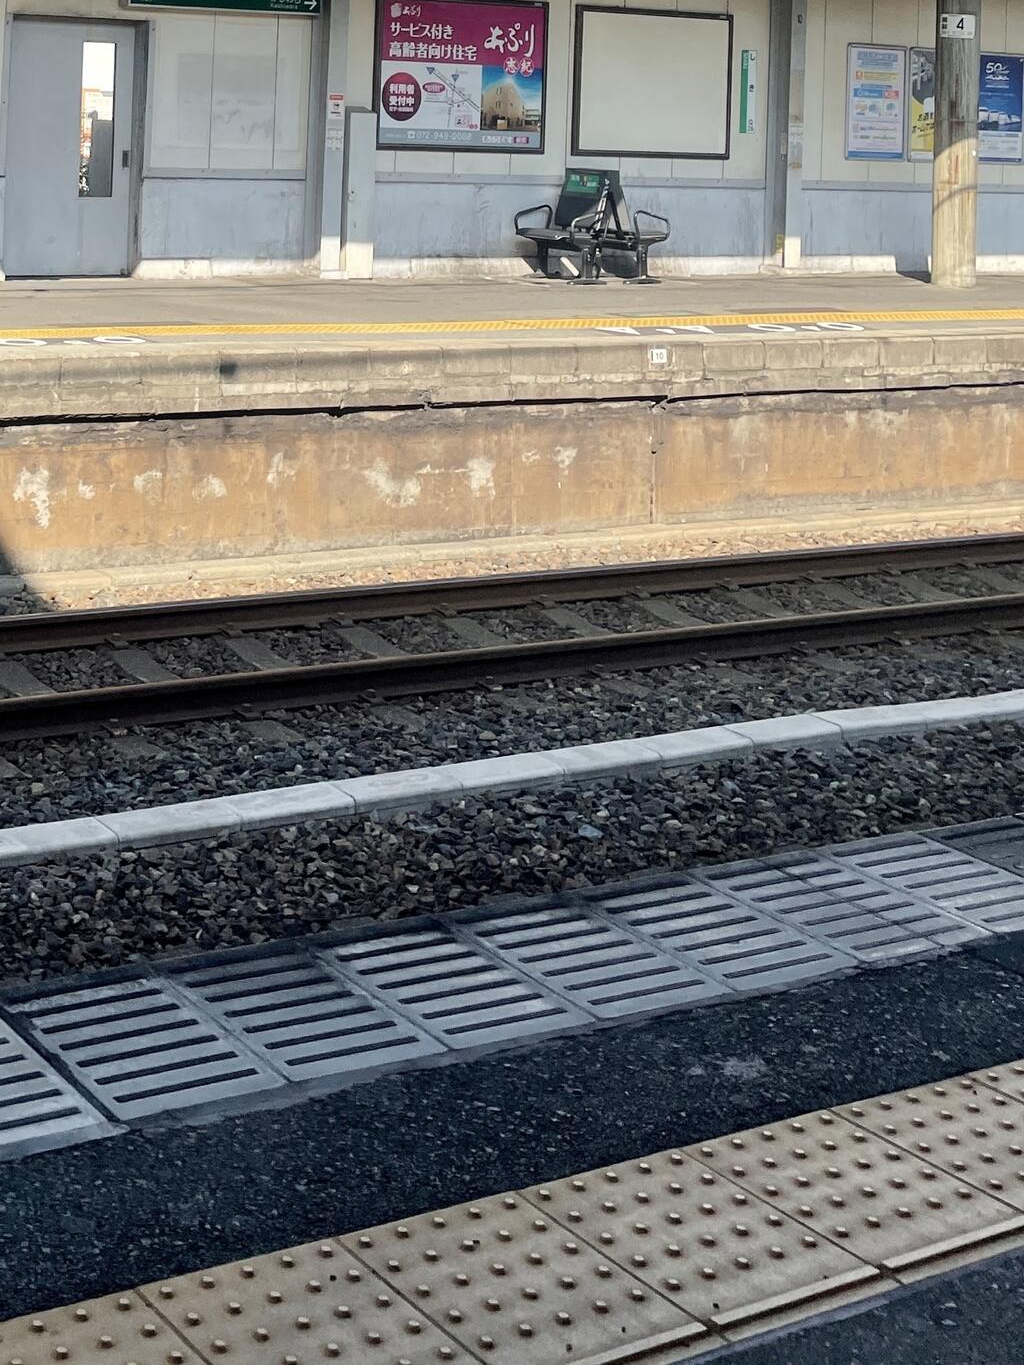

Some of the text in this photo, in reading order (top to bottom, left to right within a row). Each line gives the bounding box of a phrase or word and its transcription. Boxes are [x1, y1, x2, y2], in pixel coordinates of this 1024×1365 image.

[390, 21, 454, 40] サービス付き
[956, 17, 964, 30] 4
[389, 41, 477, 61] 高齢者向け住宅
[389, 95, 415, 107] 受付中
